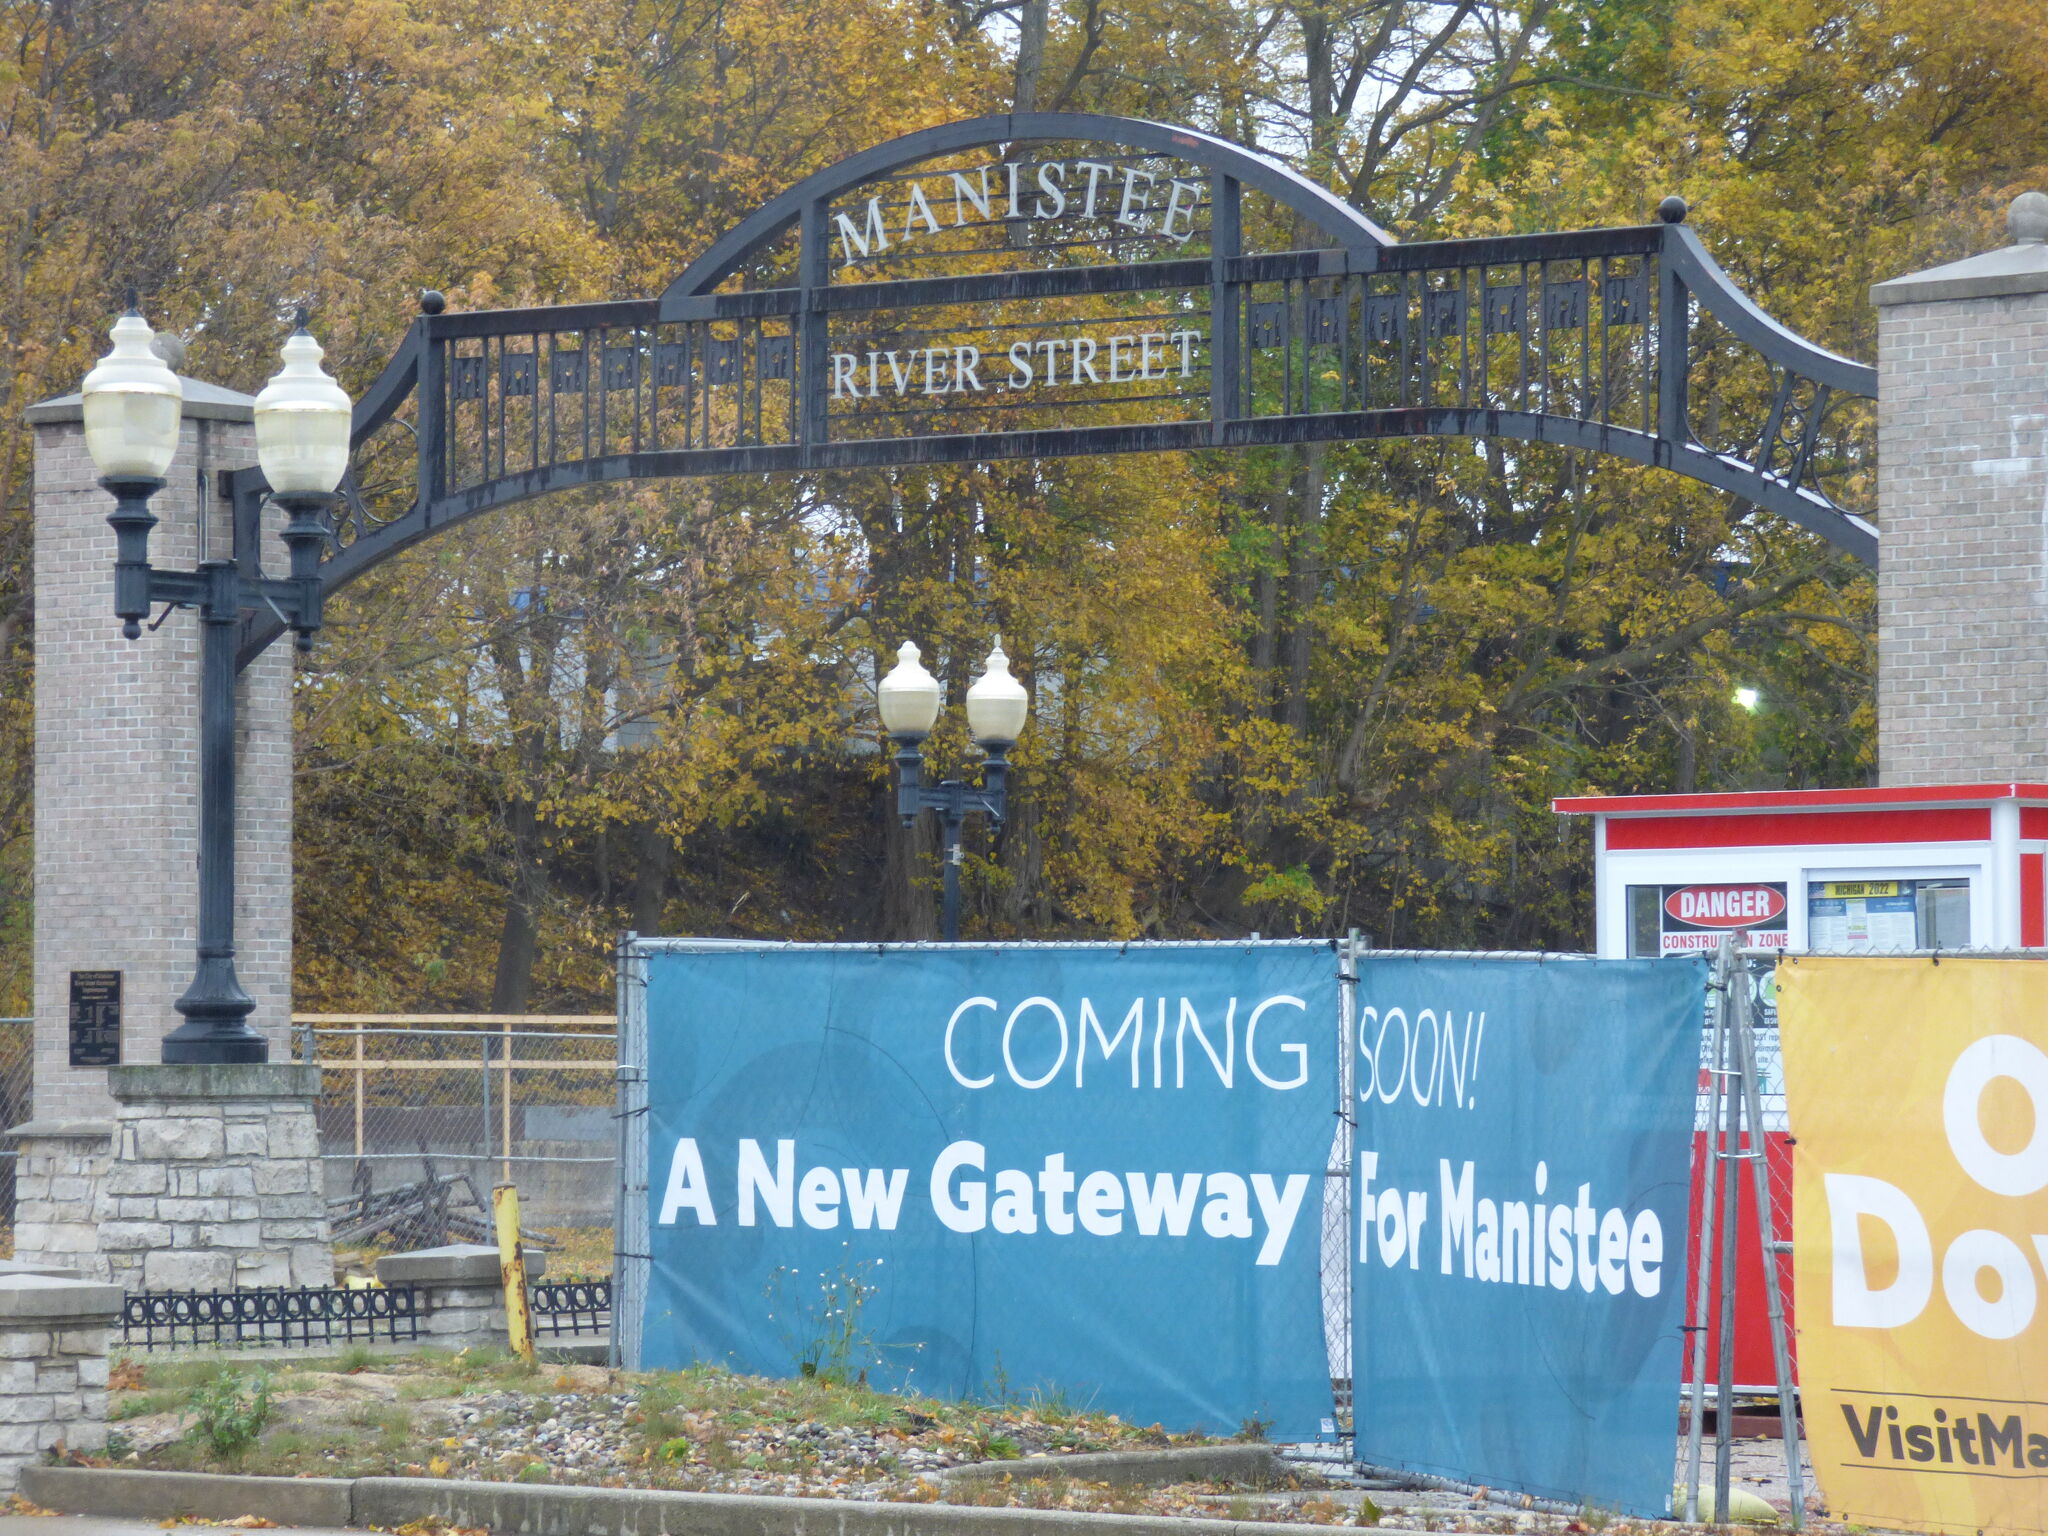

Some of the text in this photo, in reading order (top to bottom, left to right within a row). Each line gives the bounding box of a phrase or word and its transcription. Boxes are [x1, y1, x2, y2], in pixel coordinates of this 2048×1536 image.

[833, 162, 1202, 267] MANISTEE
[831, 331, 1202, 400] RIVER STREET
[1680, 890, 1770, 918] DANGER
[1835, 882, 1889, 896] MICHIGAN 2022
[1663, 933, 1788, 949] CONSTRUN ZONE
[944, 995, 1486, 1110] COMING SOON!
[658, 1137, 1664, 1298] A New Gateway For Manistee
[1824, 1173, 2048, 1340] Do
